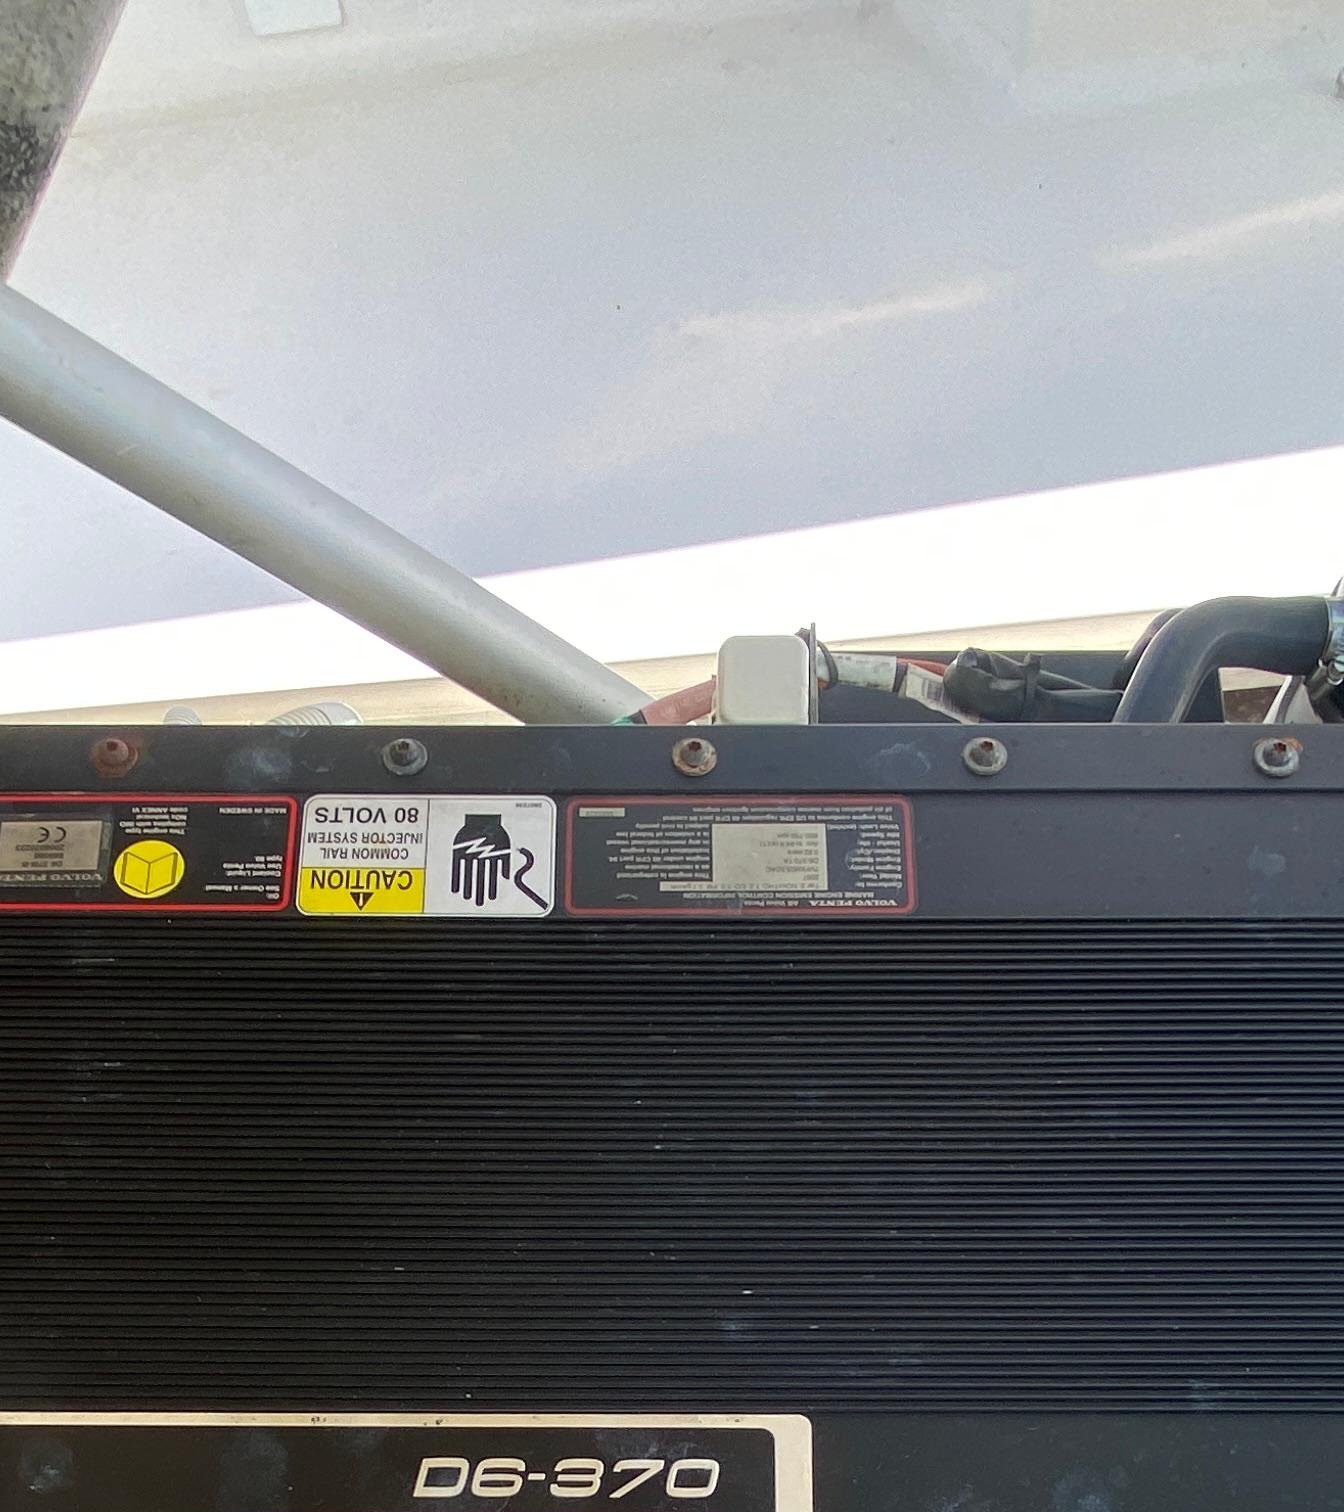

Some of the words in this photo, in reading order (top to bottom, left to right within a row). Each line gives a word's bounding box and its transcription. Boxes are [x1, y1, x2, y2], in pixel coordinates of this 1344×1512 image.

[314, 806, 387, 824] VOLTS
[394, 807, 419, 823] 80
[307, 832, 358, 844] SYSTEM
[361, 832, 423, 844] INJECTOR
[320, 847, 348, 860] RAIL
[351, 847, 409, 860] COMMON
[50, 873, 102, 881] VOLVO
[310, 869, 413, 890] CAUTION
[413, 1457, 720, 1498] D6-370
